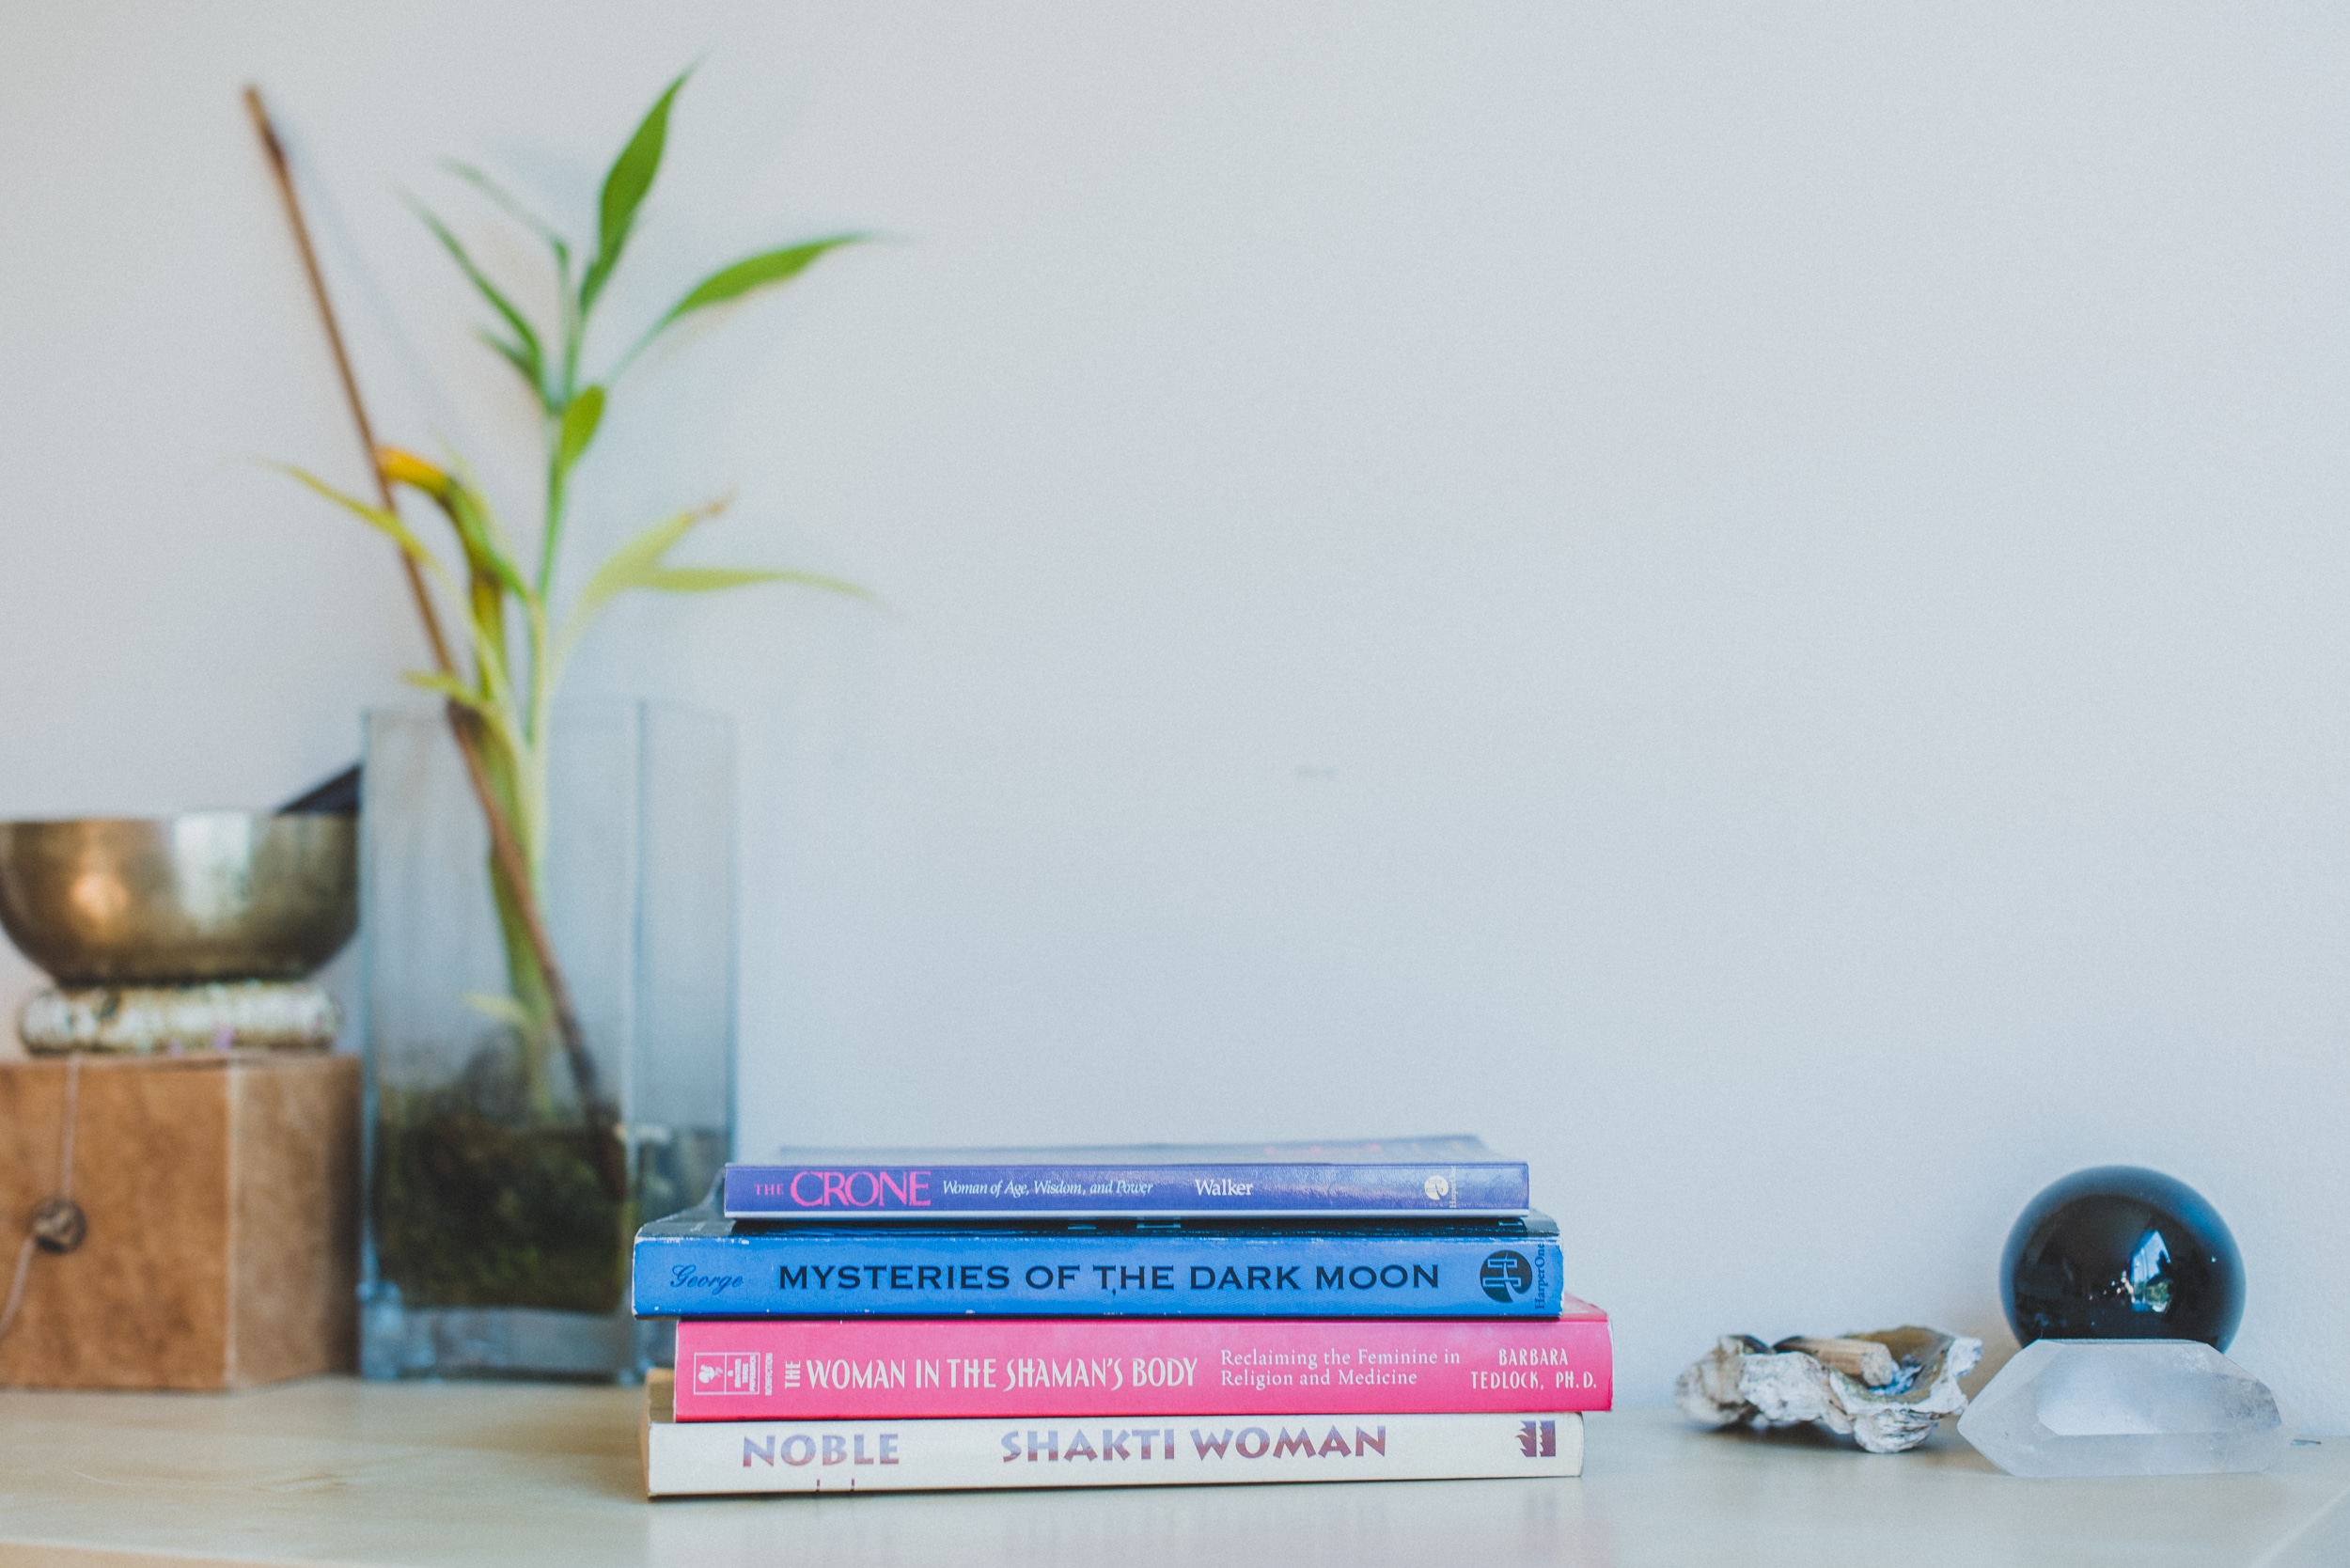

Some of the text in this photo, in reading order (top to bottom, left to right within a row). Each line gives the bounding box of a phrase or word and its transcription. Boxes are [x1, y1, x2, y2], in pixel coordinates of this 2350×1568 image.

[755, 1170, 932, 1207] THE CRONE
[943, 1181, 1153, 1198] Woman of Age, Wisdom, and Power
[1195, 1179, 1254, 1196] Walker
[668, 1263, 744, 1294] George
[779, 1264, 1439, 1290] MYSTERIES OF THE DARK MOON
[1535, 1243, 1548, 1309] HarperOne
[1221, 1348, 1461, 1370] Reclaiming the Feminine in
[1498, 1348, 1569, 1367] BARBARA
[784, 1359, 801, 1389] THE
[806, 1356, 1198, 1392] WOMAN IN THE SHAMAN'S BODY
[1221, 1368, 1418, 1391] Religion and Medicine
[1470, 1371, 1544, 1391] TEDLOCK,
[743, 1434, 900, 1467] NOBLE
[1000, 1424, 1386, 1463] SHAKTI WOMAN
